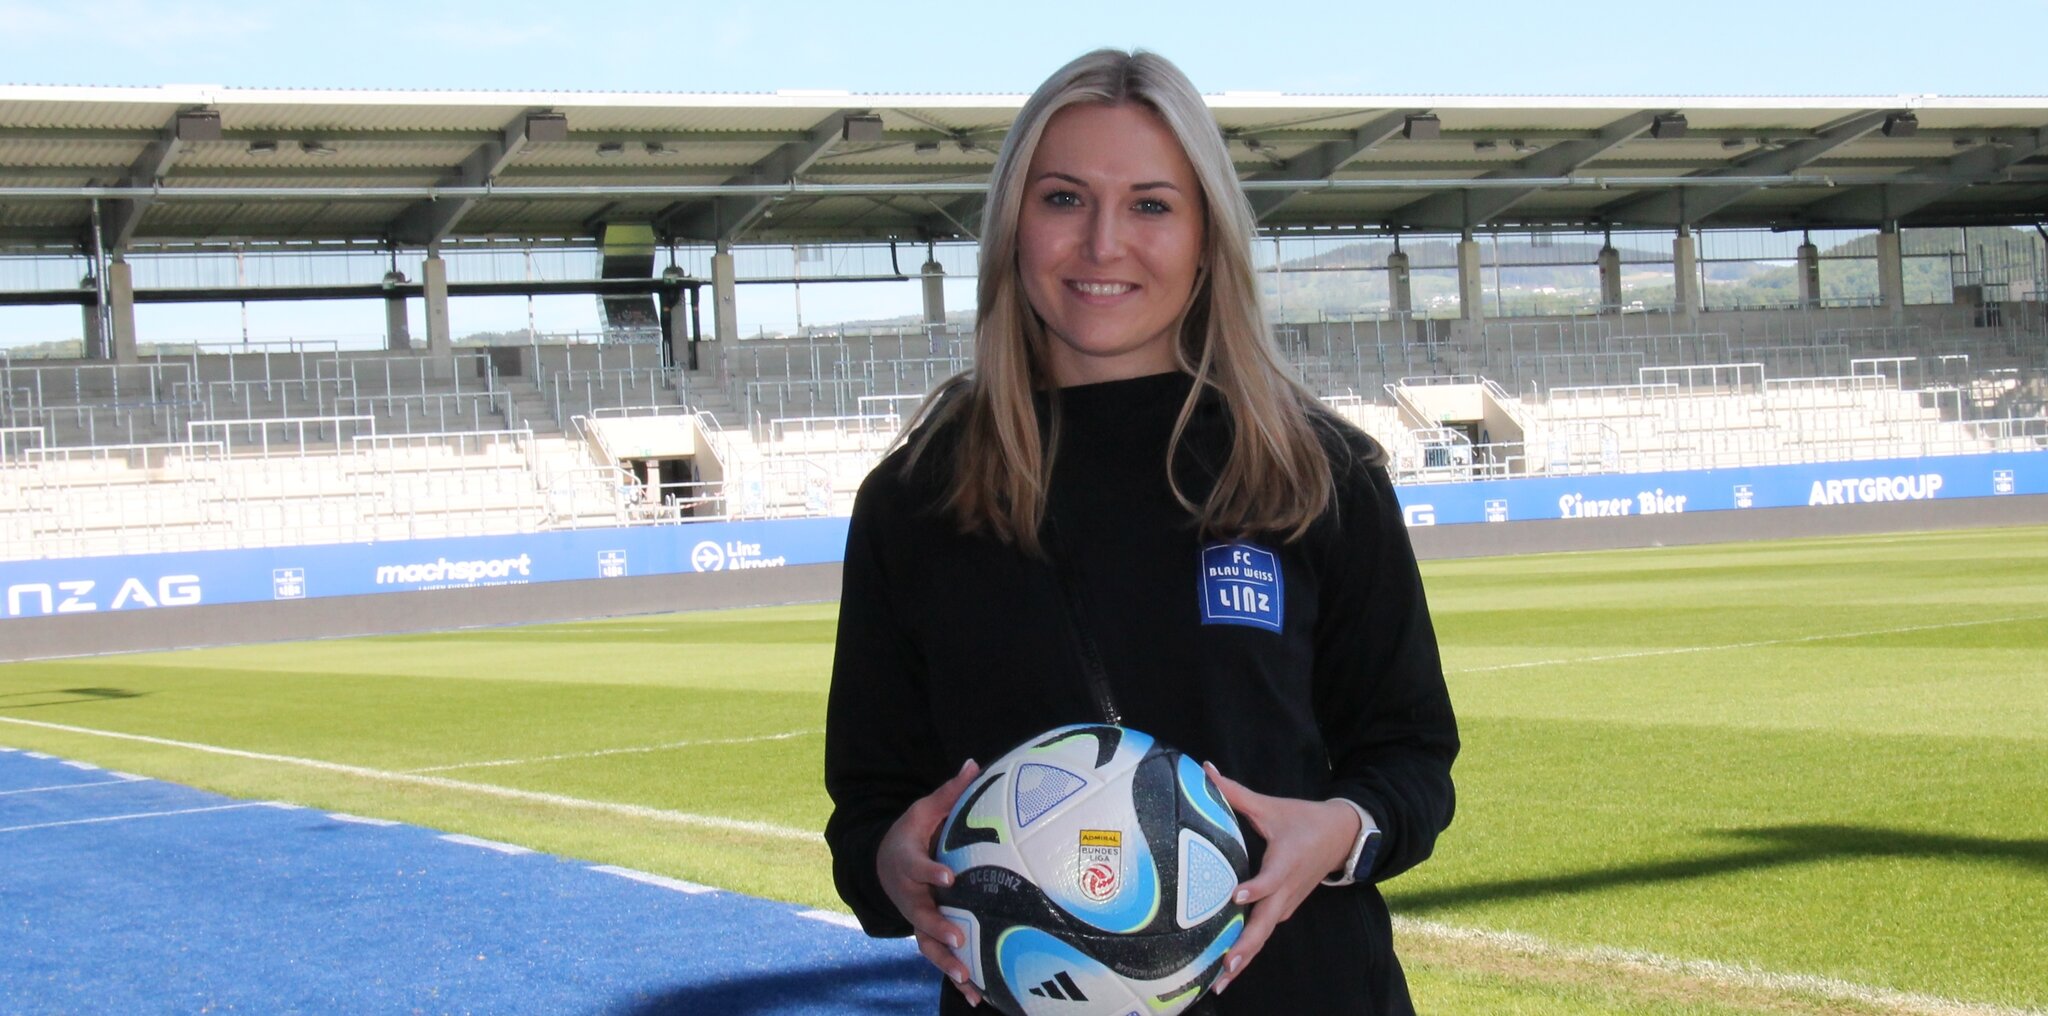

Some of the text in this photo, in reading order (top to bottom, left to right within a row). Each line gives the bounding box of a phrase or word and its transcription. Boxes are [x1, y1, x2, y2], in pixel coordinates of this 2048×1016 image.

[1559, 487, 1687, 519] Linzer Bier
[1808, 473, 1943, 506] ARTGROUP
[726, 540, 761, 557] Linz
[1233, 551, 1252, 566] FC
[376, 553, 531, 584] machsport
[1209, 566, 1273, 582] BLAU WEISS
[0, 574, 201, 615] NZ AG
[1219, 584, 1270, 613] LINZ
[1081, 846, 1119, 856] BUNDES
